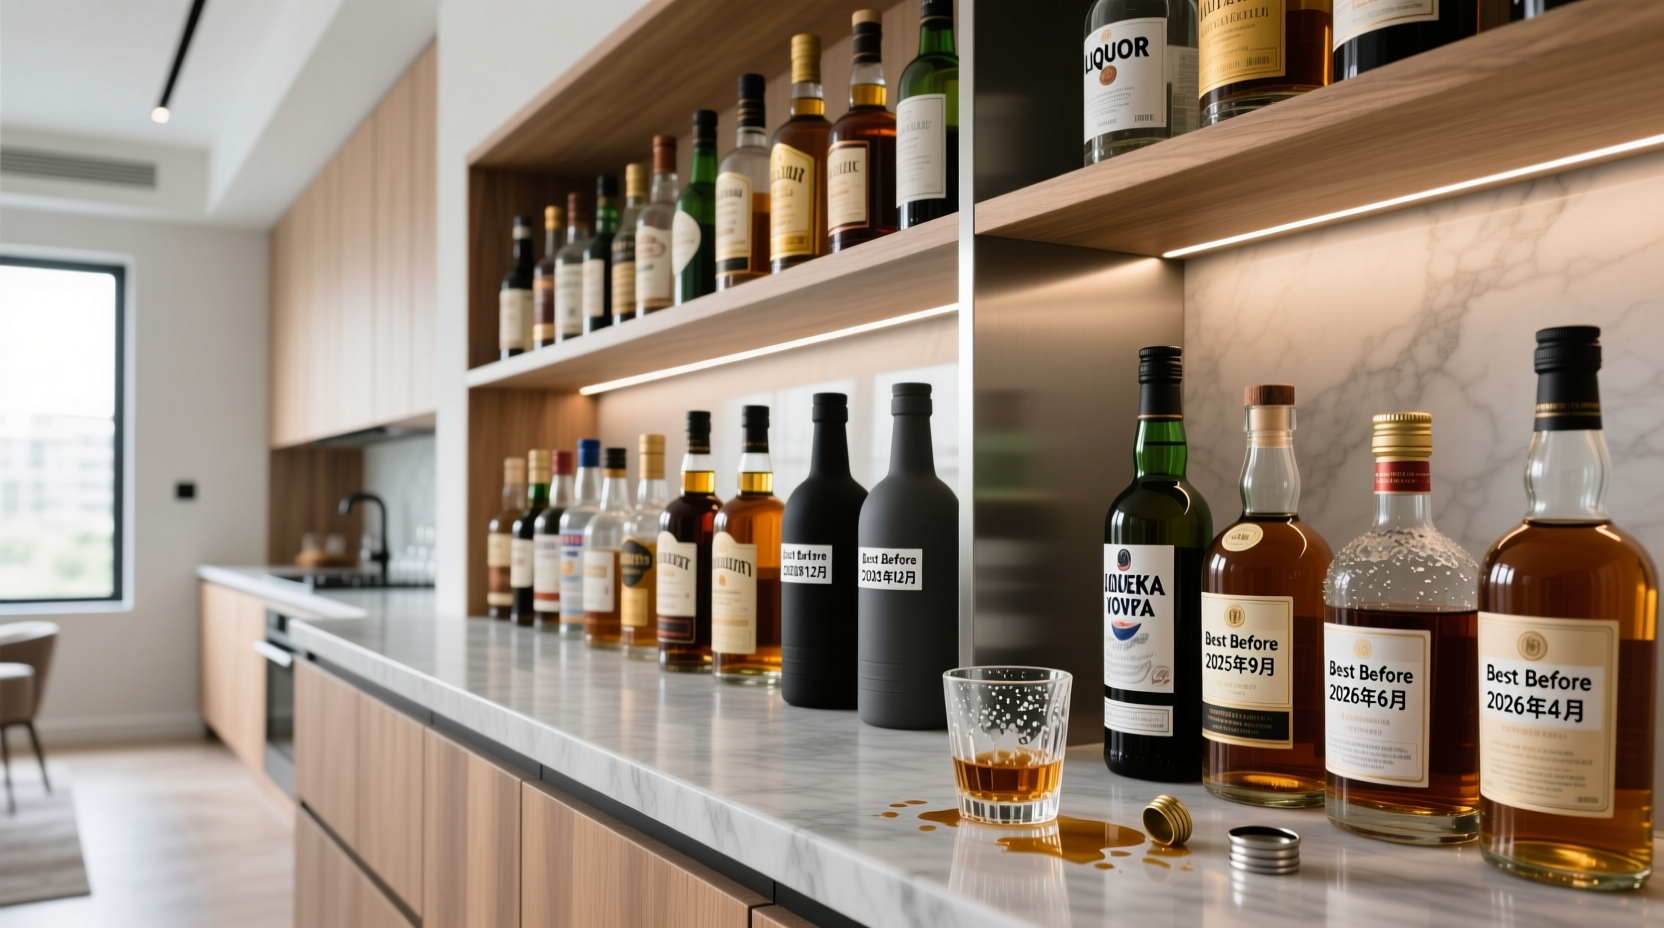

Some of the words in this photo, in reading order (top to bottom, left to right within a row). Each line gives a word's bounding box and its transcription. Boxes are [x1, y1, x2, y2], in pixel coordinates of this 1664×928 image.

[1085, 36, 1150, 75] LIQUOR
[1205, 631, 1227, 647] Best
[1230, 634, 1279, 651] Before
[1205, 653, 1275, 677] 2025年9月
[1329, 660, 1355, 679] Best
[1359, 664, 1414, 684] Before
[1486, 664, 1519, 685] Best
[1525, 669, 1592, 691] Before
[1329, 684, 1406, 711] 2026年6月
[1487, 691, 1584, 723] 2026年4月
